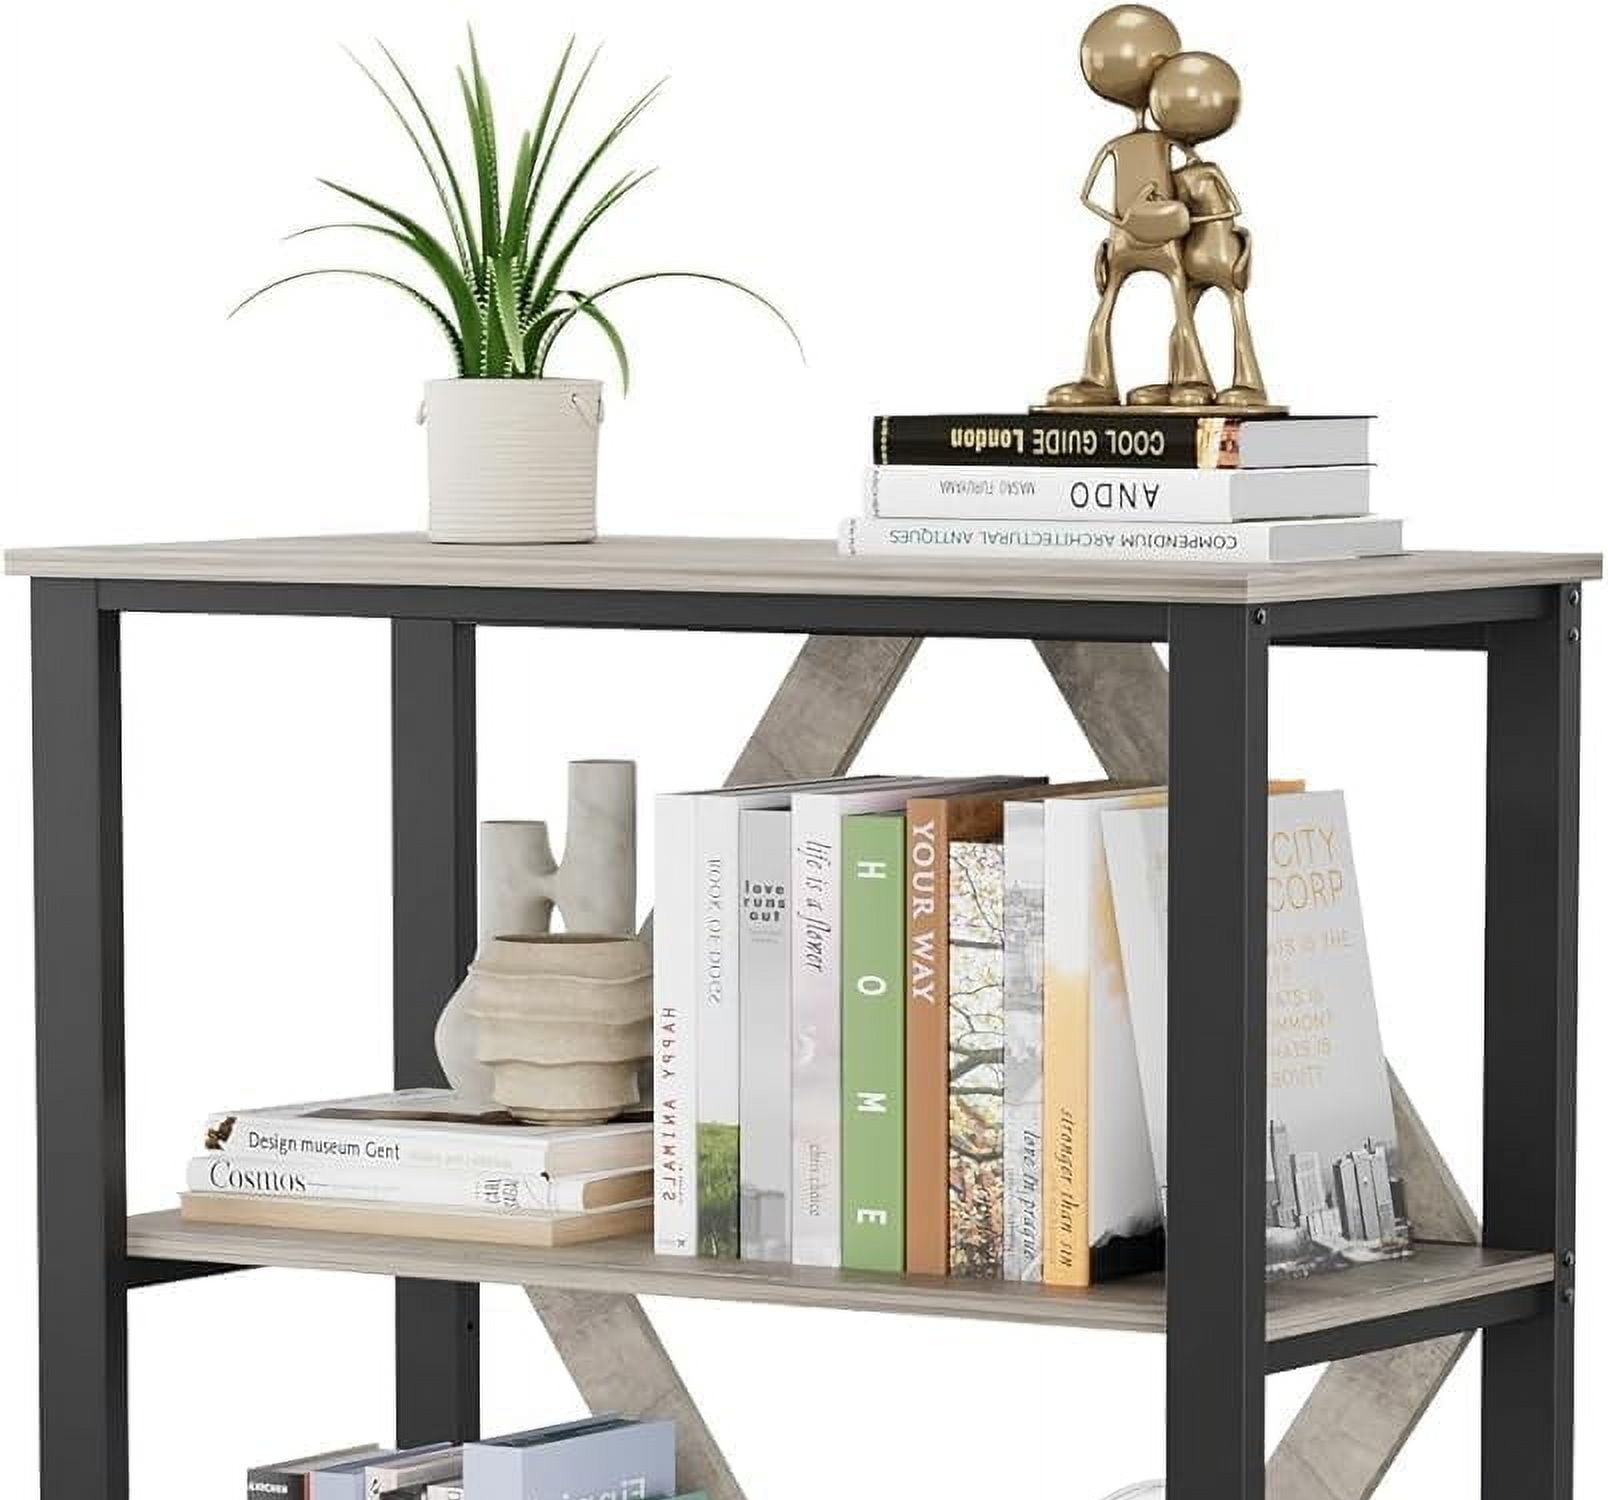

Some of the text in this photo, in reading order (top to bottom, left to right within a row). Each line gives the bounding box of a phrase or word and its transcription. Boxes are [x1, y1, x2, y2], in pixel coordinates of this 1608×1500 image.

[950, 425, 1165, 456] COOL GUIDE London
[1070, 481, 1160, 510] ANDO
[889, 530, 1238, 551] COMPENDIUM ARCHITECTURAL ANTIQUES
[1270, 829, 1335, 868] CITY
[743, 897, 785, 909] runs
[744, 879, 785, 896] love
[1267, 870, 1344, 912] CORP
[749, 910, 780, 922] out
[796, 840, 831, 973] life is a flower
[910, 821, 935, 1003] YOUR WAY
[248, 1131, 400, 1161] Design museum Gent
[1021, 1129, 1041, 1166] love
[209, 1158, 306, 1193] Cosmos
[1060, 1191, 1080, 1233] than
[1059, 1240, 1074, 1268] sin
